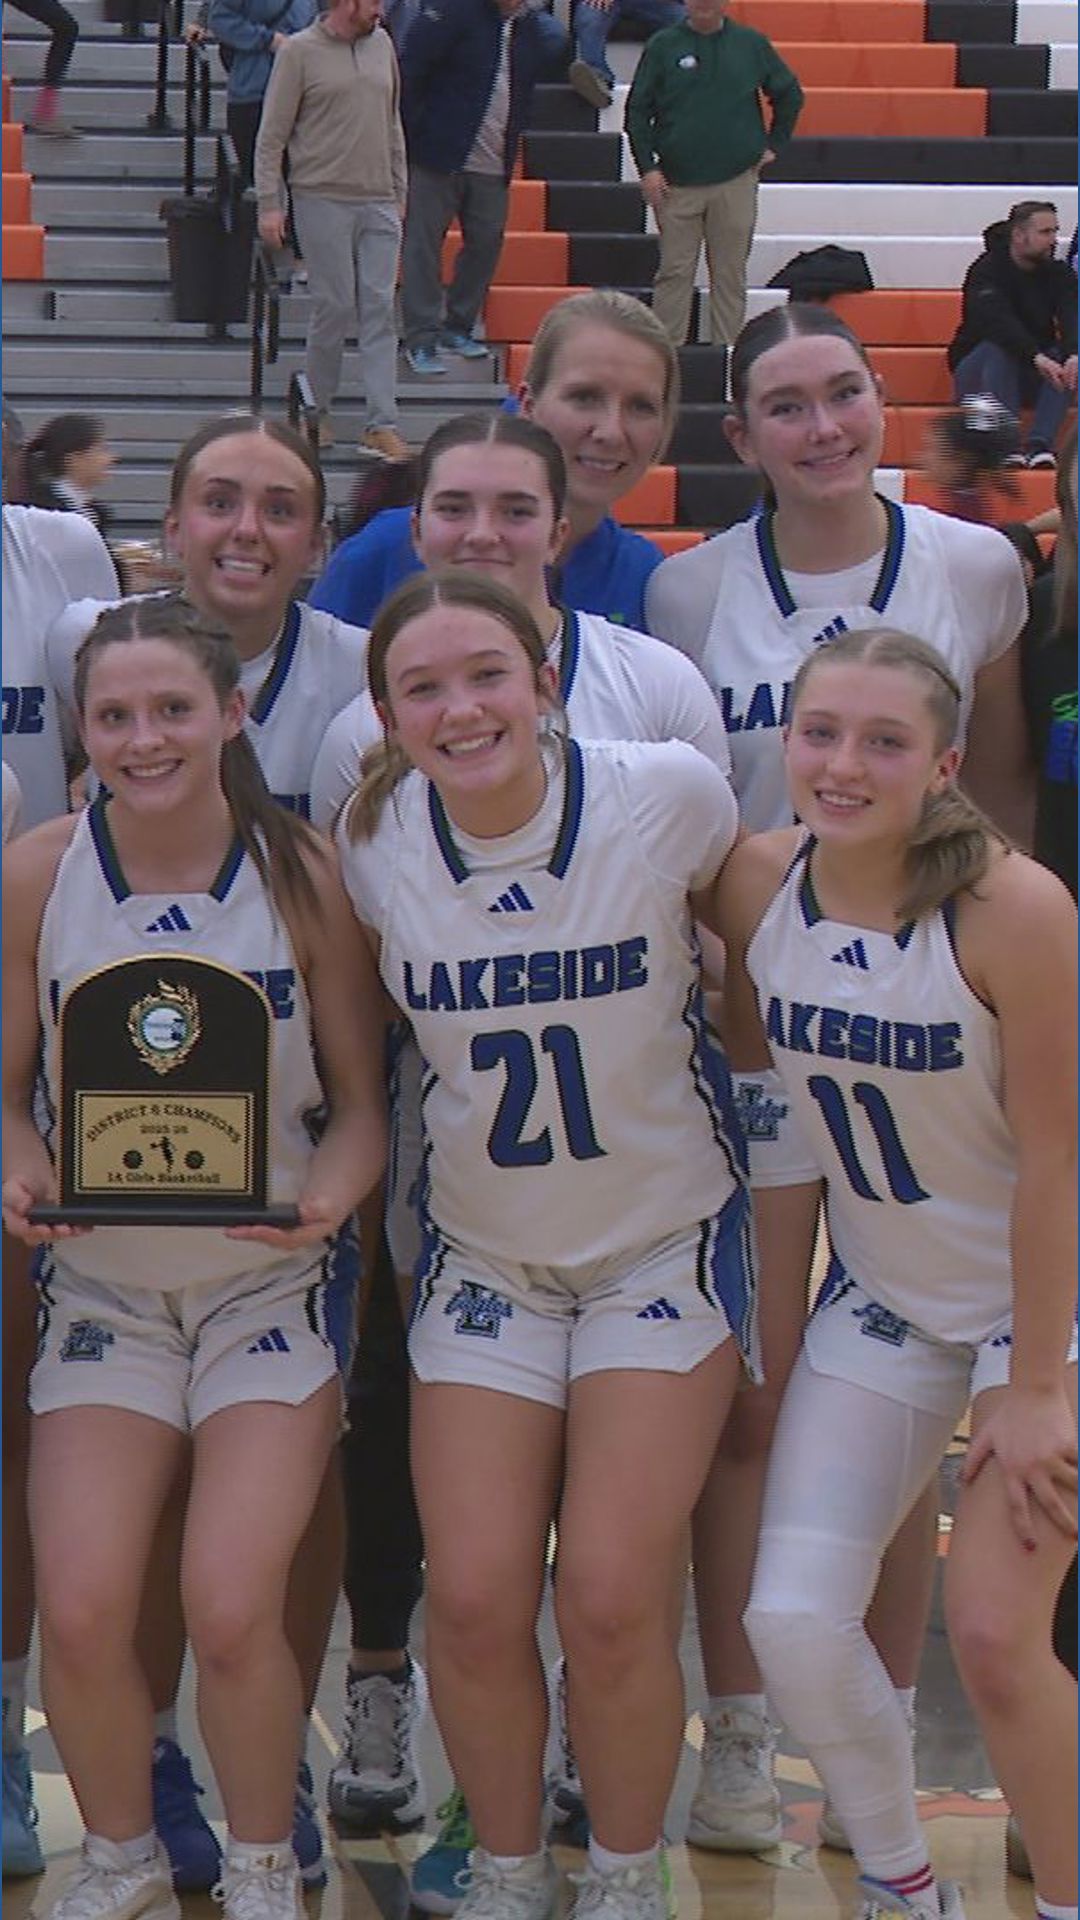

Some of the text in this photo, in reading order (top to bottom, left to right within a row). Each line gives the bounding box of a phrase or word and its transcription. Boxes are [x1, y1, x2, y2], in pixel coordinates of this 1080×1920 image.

[721, 681, 792, 734] LA
[402, 936, 648, 1012] LAKESIDE
[86, 1103, 148, 1142] DISTRICT
[470, 1024, 608, 1168] 21
[806, 1074, 933, 1205] 11
